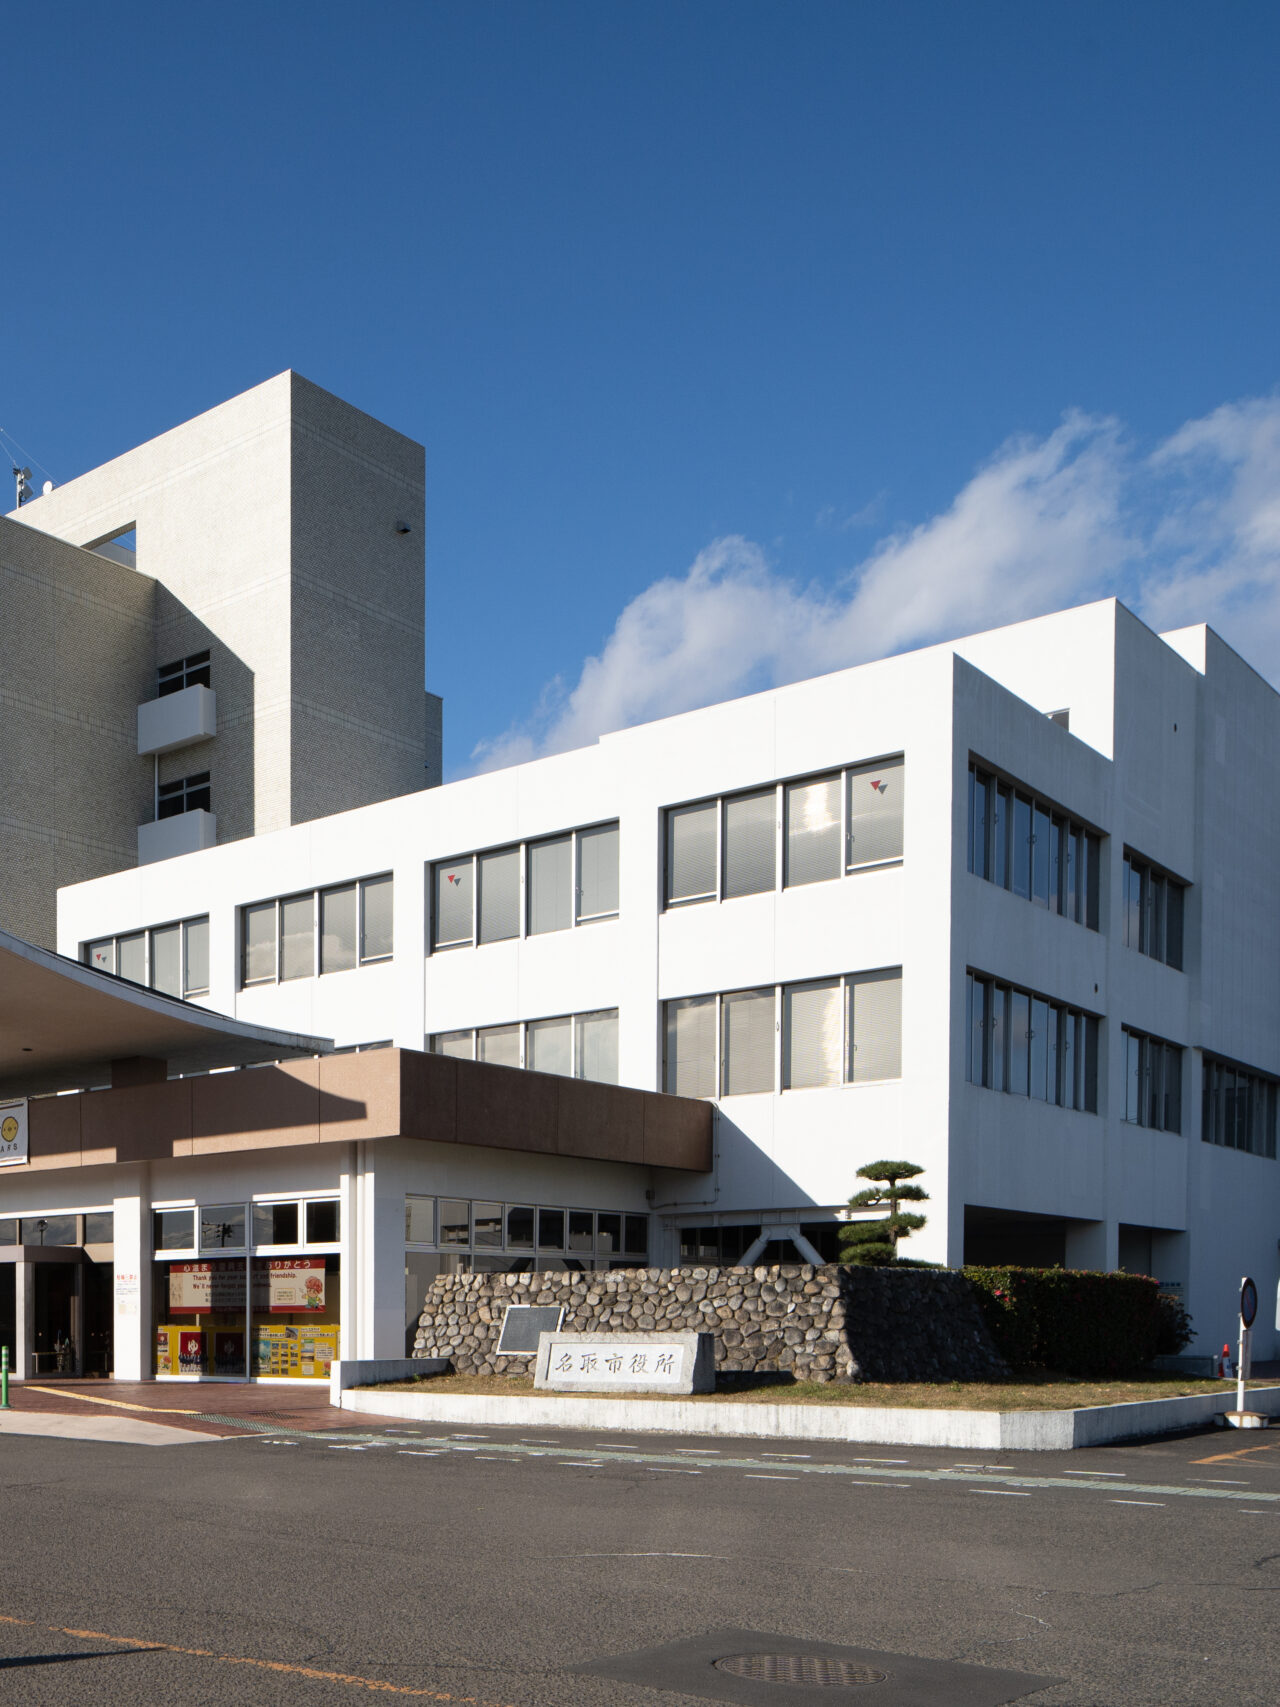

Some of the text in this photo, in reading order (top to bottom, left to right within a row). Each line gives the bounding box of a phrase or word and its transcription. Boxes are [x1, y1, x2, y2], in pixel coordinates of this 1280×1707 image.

[555, 1352, 676, 1375] 名取市役所
